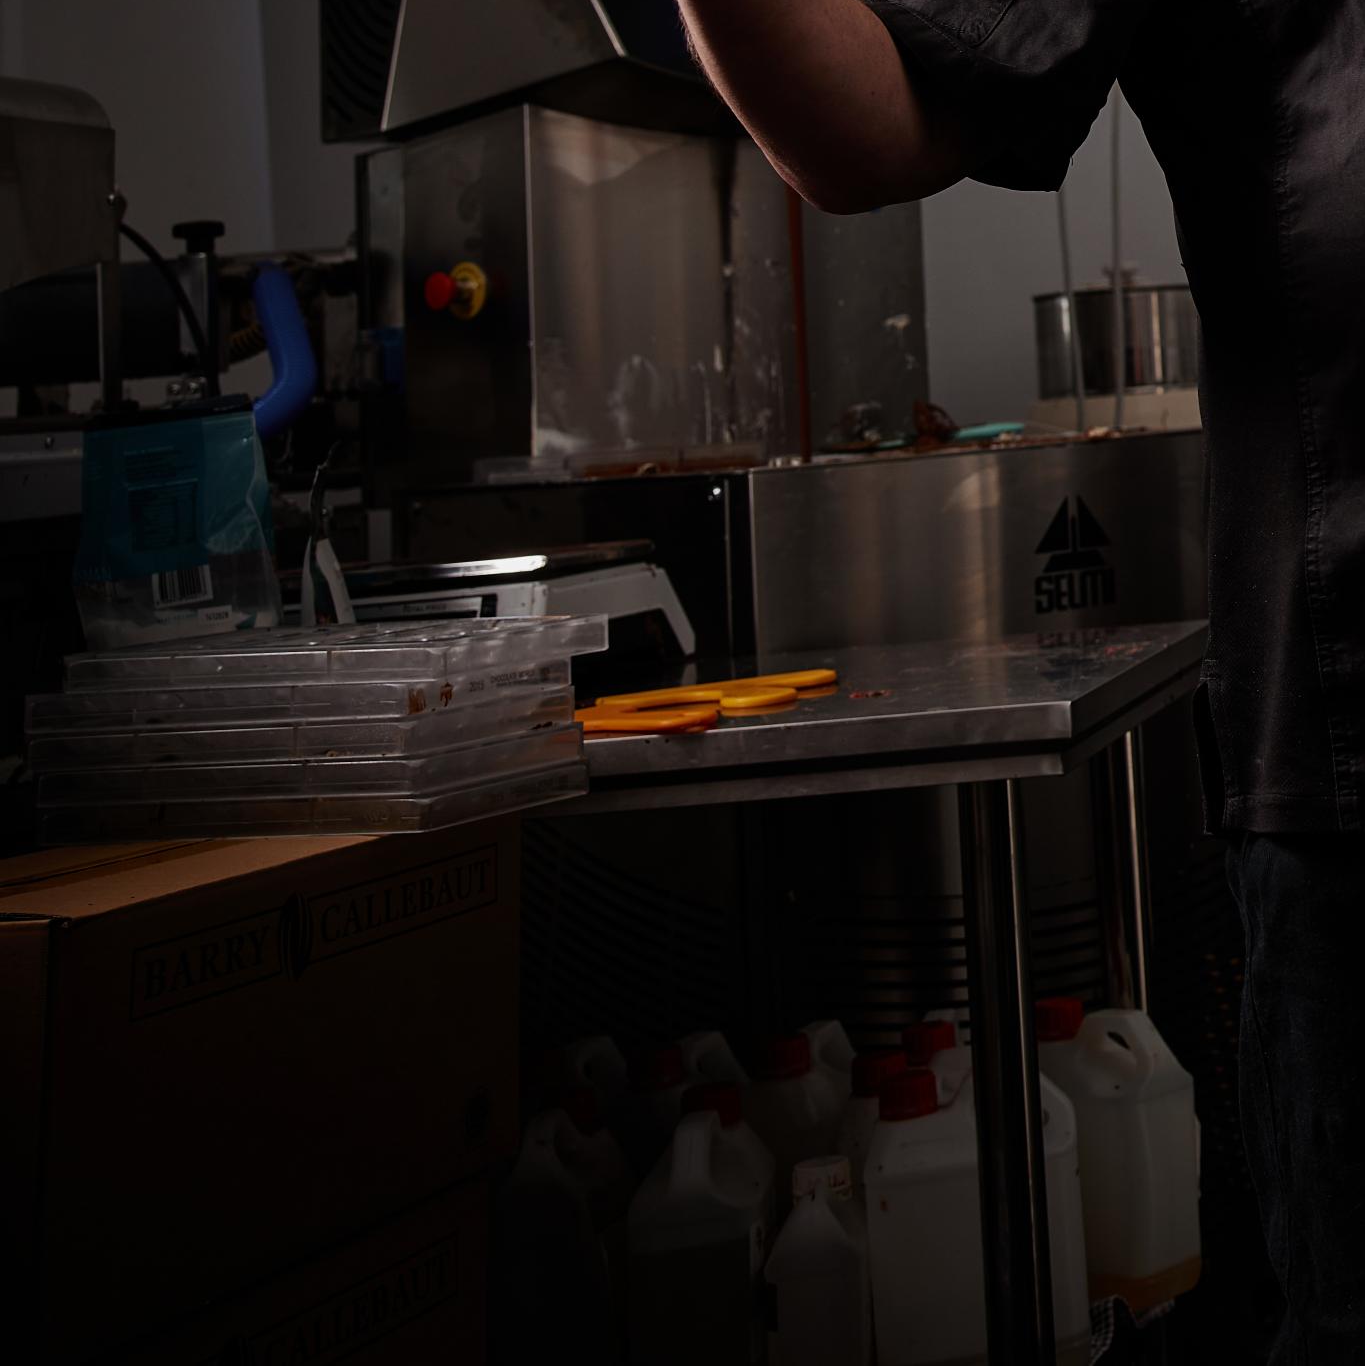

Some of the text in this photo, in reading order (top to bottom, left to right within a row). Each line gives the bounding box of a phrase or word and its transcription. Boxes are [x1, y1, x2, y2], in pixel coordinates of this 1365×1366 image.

[1035, 568, 1115, 614] SELMI
[144, 858, 491, 1002] BARRY CALLEBAUT
[264, 1249, 451, 1366] CALLEBAUT
